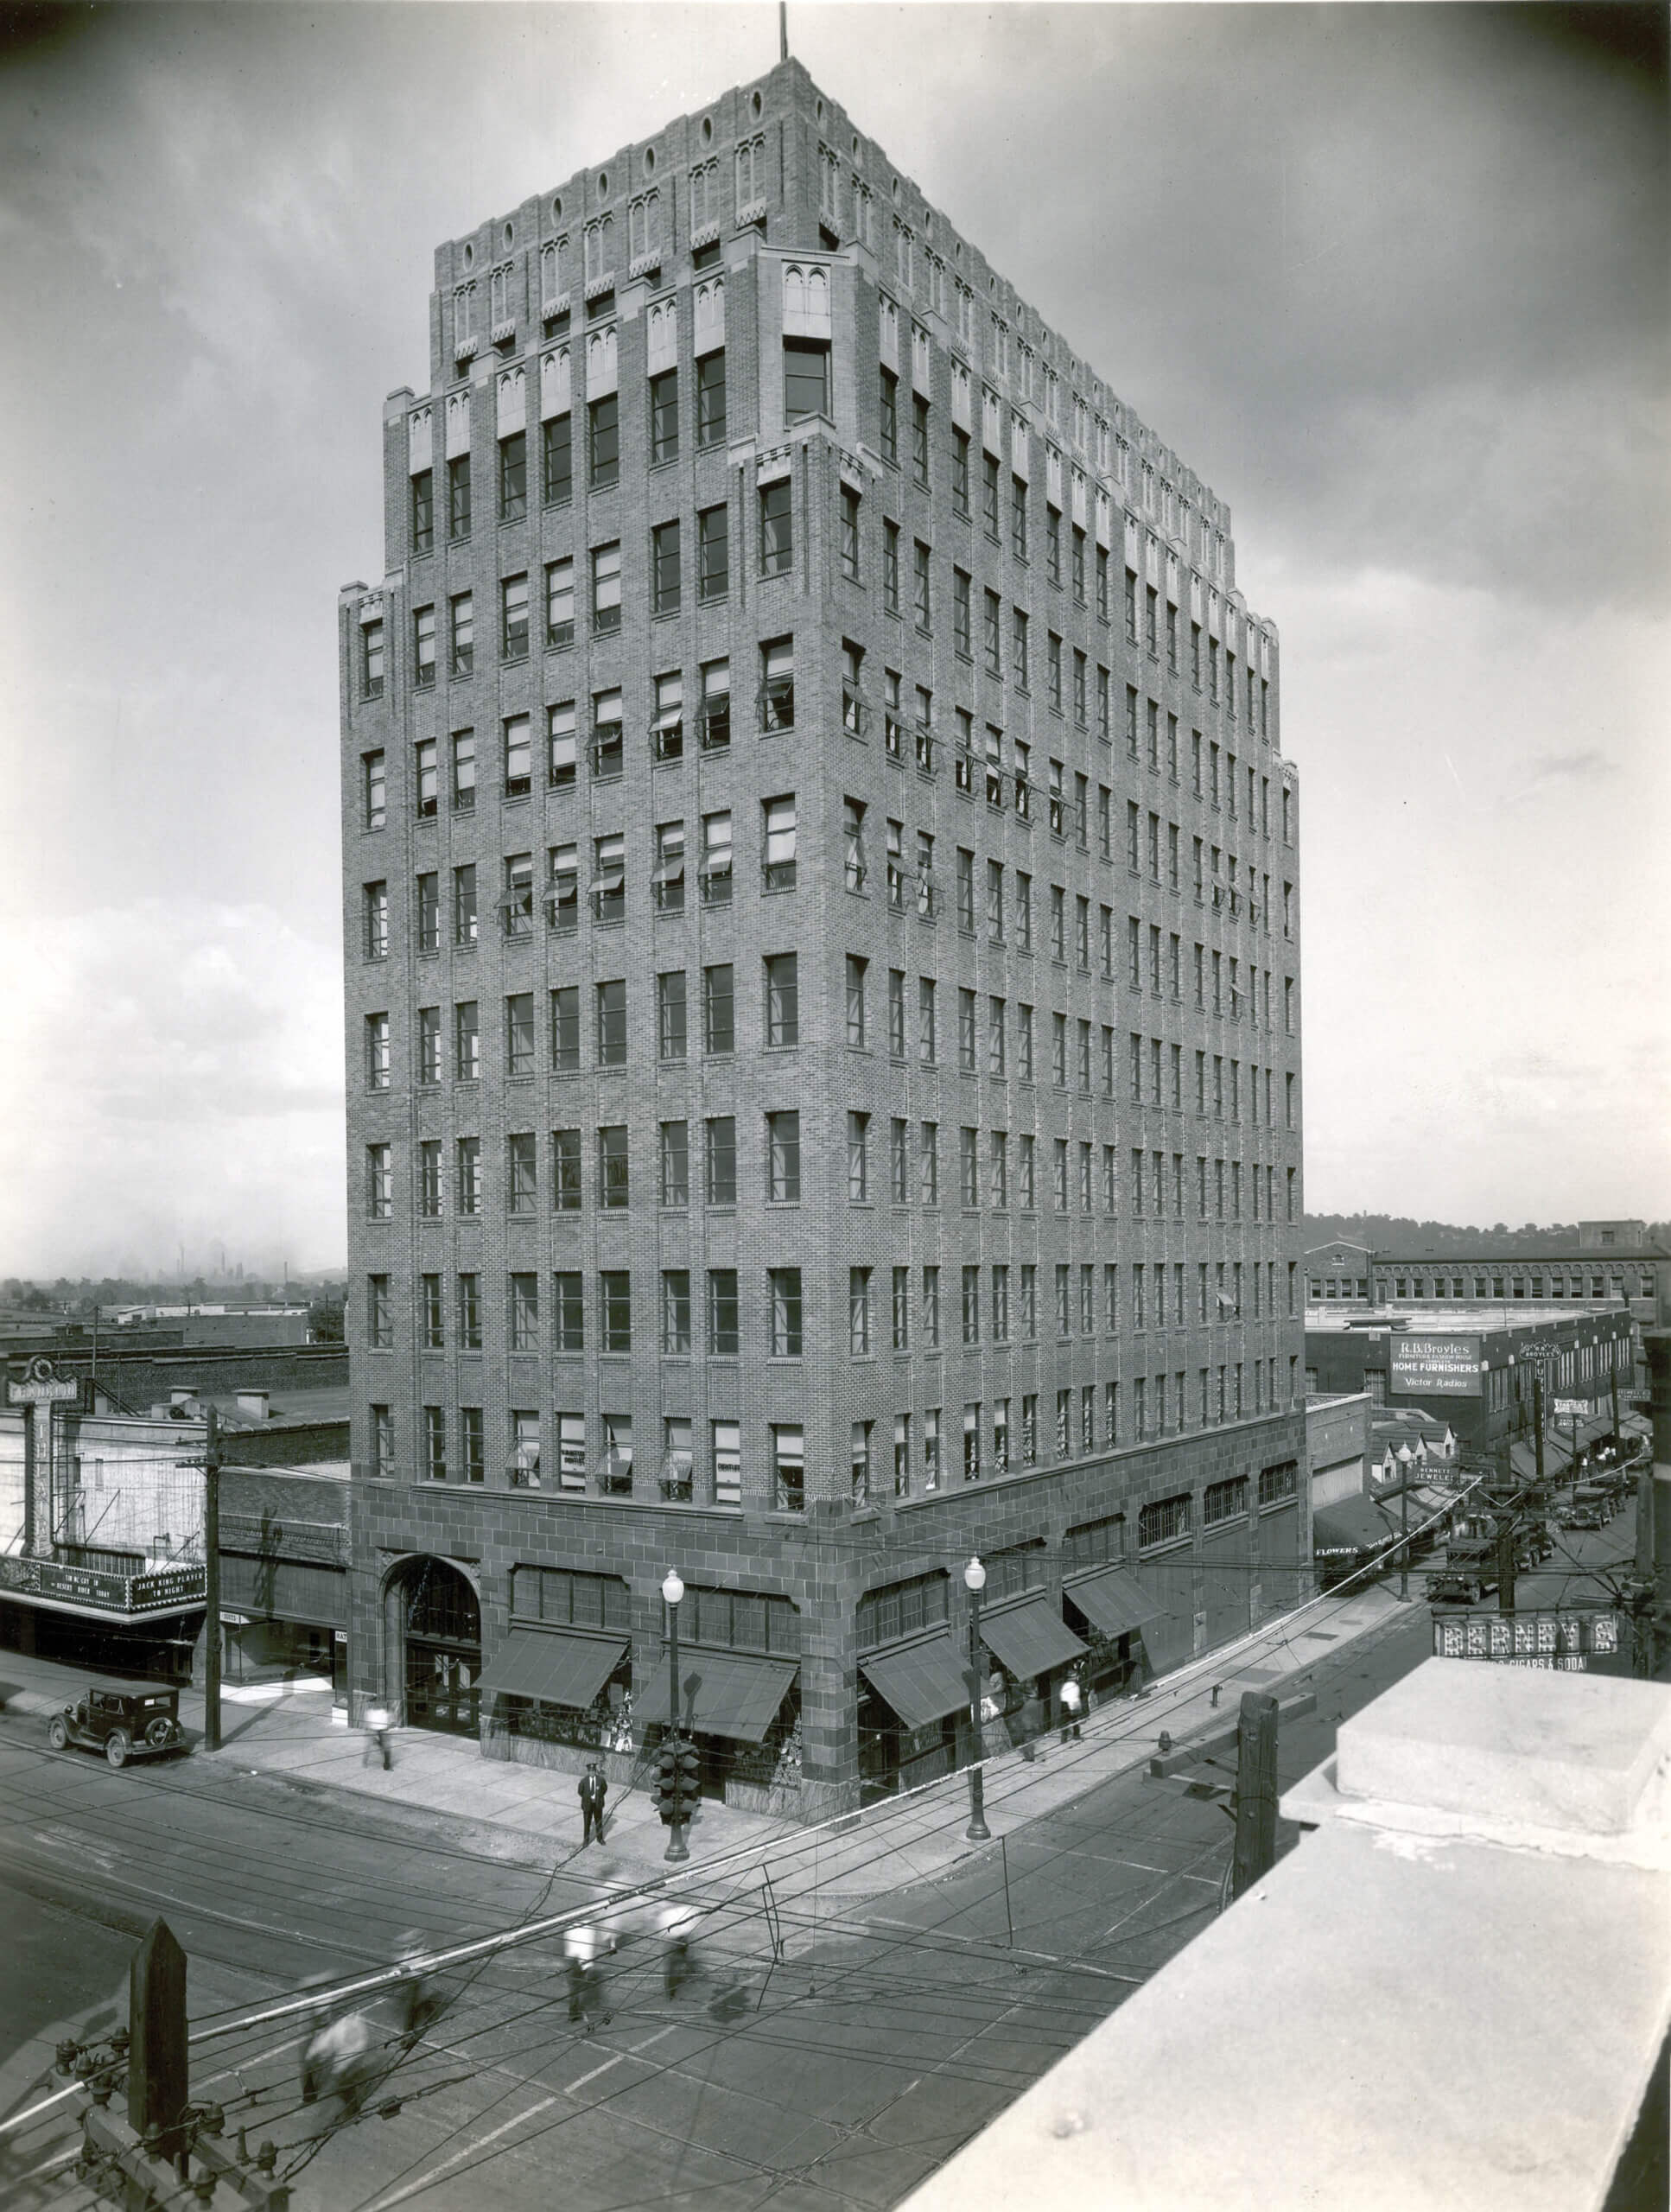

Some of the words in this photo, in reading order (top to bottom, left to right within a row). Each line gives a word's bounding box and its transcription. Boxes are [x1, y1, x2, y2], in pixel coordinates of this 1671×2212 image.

[1392, 1362, 1418, 1371] HOME
[1420, 1362, 1479, 1373] FURNISHERS
[1404, 1377, 1432, 1387] Victor
[1436, 1378, 1468, 1389] Radios
[1316, 1547, 1359, 1556] FLOWERS
[137, 1580, 155, 1591] JACK
[158, 1577, 174, 1586] KING
[1548, 1657, 1554, 1670] &
[1557, 1656, 1585, 1671] SODA
